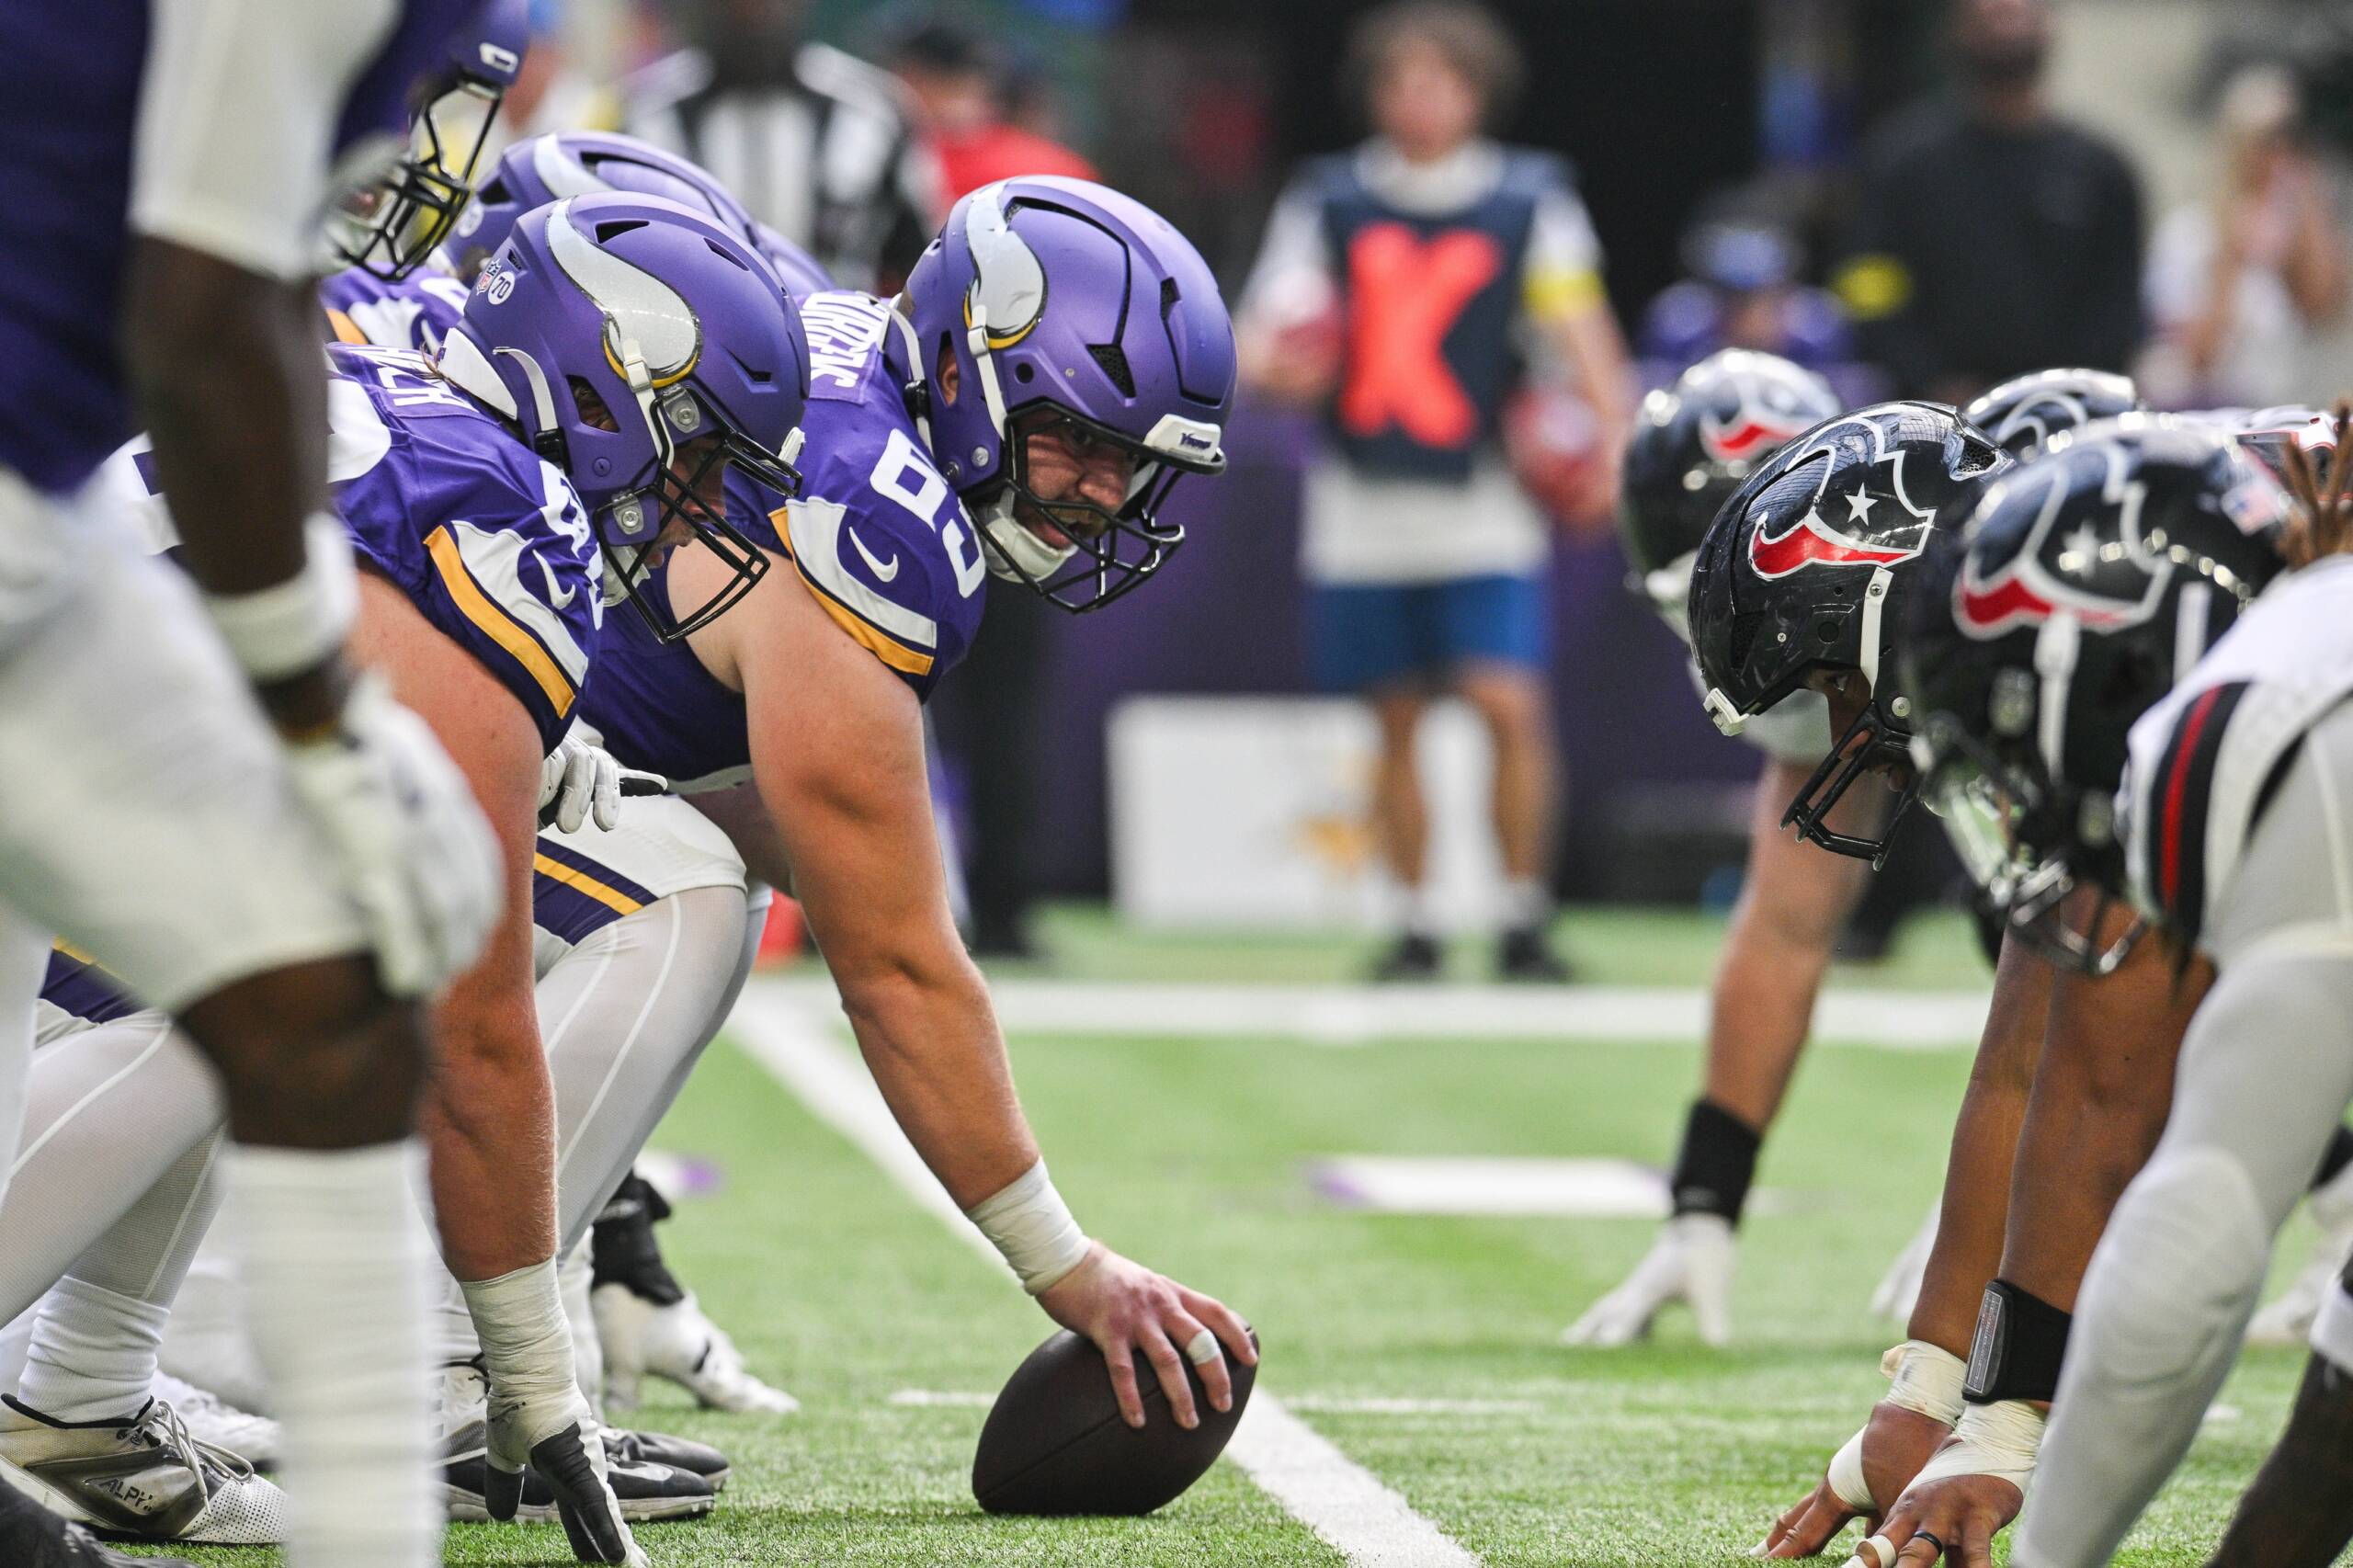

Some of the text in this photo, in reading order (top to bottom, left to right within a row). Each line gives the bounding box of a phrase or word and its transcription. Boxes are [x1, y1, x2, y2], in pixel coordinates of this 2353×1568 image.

[491, 276, 511, 300] 70
[1343, 223, 1502, 447] K
[98, 1479, 153, 1511] ALPH
